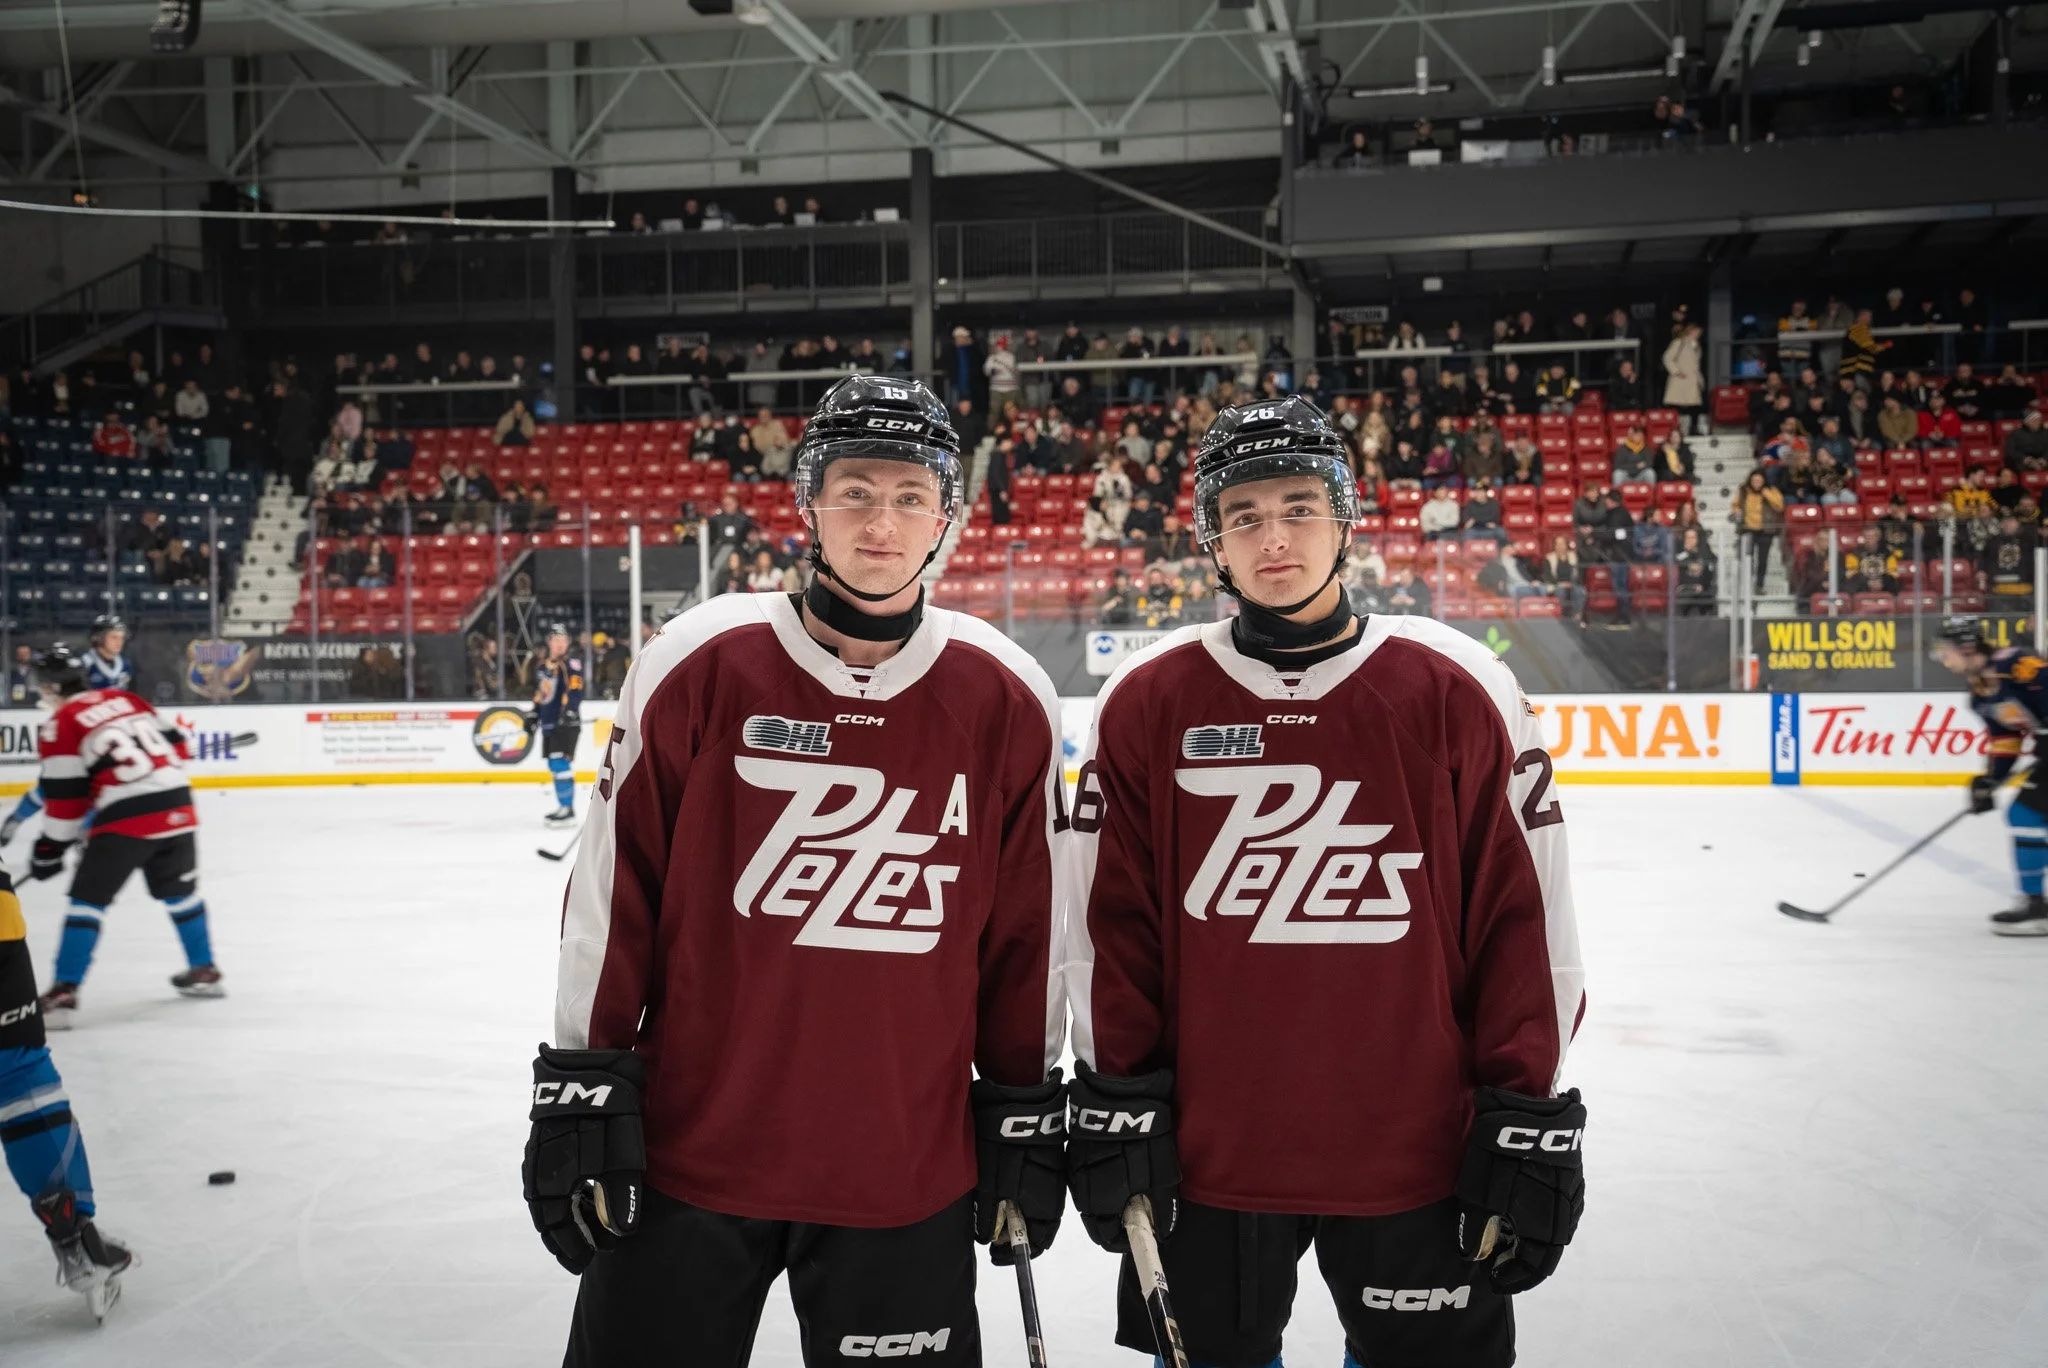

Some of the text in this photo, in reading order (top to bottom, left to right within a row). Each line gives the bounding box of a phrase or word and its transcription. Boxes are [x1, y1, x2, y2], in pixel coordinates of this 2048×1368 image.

[880, 386, 909, 400] 15
[866, 417, 924, 433] CCM
[1242, 407, 1275, 424] 26
[1235, 436, 1291, 454] CCM
[1766, 620, 1896, 651] WILLSON
[1768, 652, 1896, 669] SAND & GRAVEL
[835, 714, 886, 727] CCM
[1266, 714, 1318, 725] CCM
[1807, 705, 1895, 756] Tim
[198, 732, 238, 760] HL
[743, 715, 832, 757] OHL
[1182, 724, 1265, 760] OHL
[599, 723, 626, 804] 5
[938, 773, 969, 836] A
[533, 1082, 613, 1107] CM
[1000, 1110, 1065, 1138] CC
[1070, 1104, 1156, 1133] CM
[1362, 1285, 1471, 1311] CCM
[839, 1327, 951, 1358] CCM
